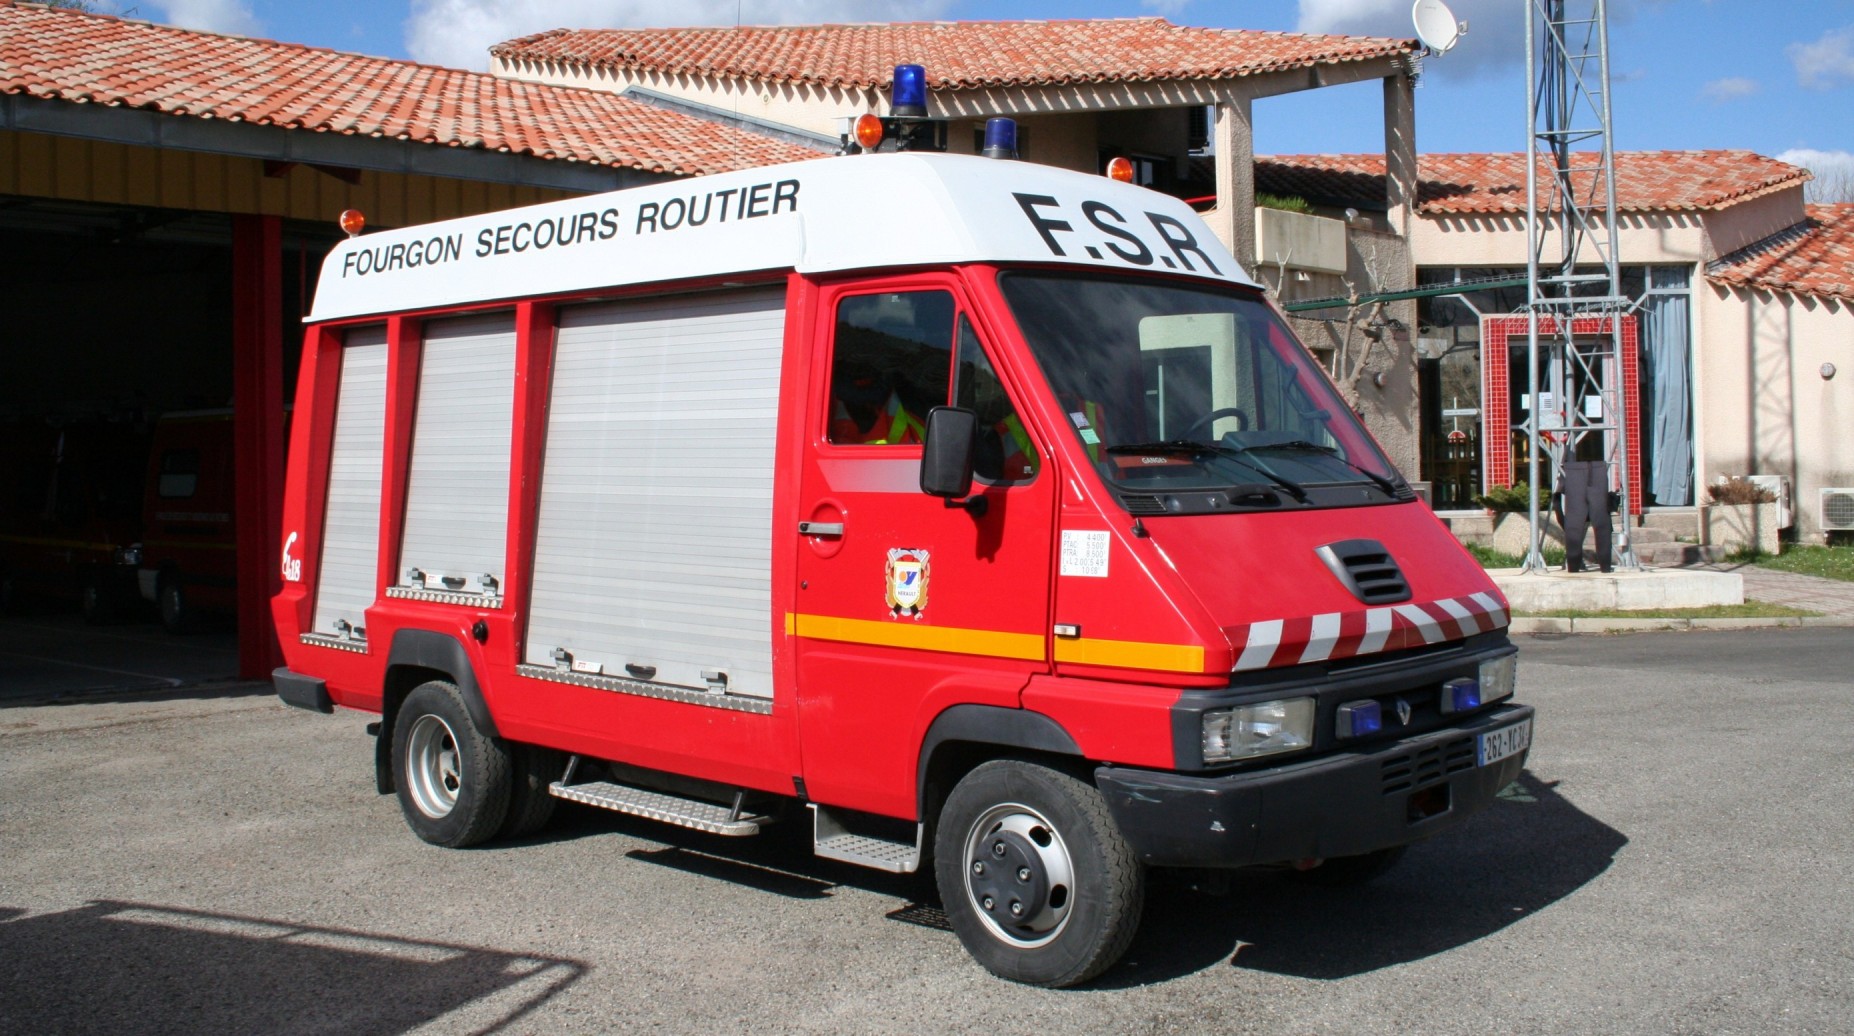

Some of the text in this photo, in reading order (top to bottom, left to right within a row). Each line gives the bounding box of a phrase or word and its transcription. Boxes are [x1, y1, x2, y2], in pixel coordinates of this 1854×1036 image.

[342, 179, 801, 279] FOURGON SECOURS ROUTIER
